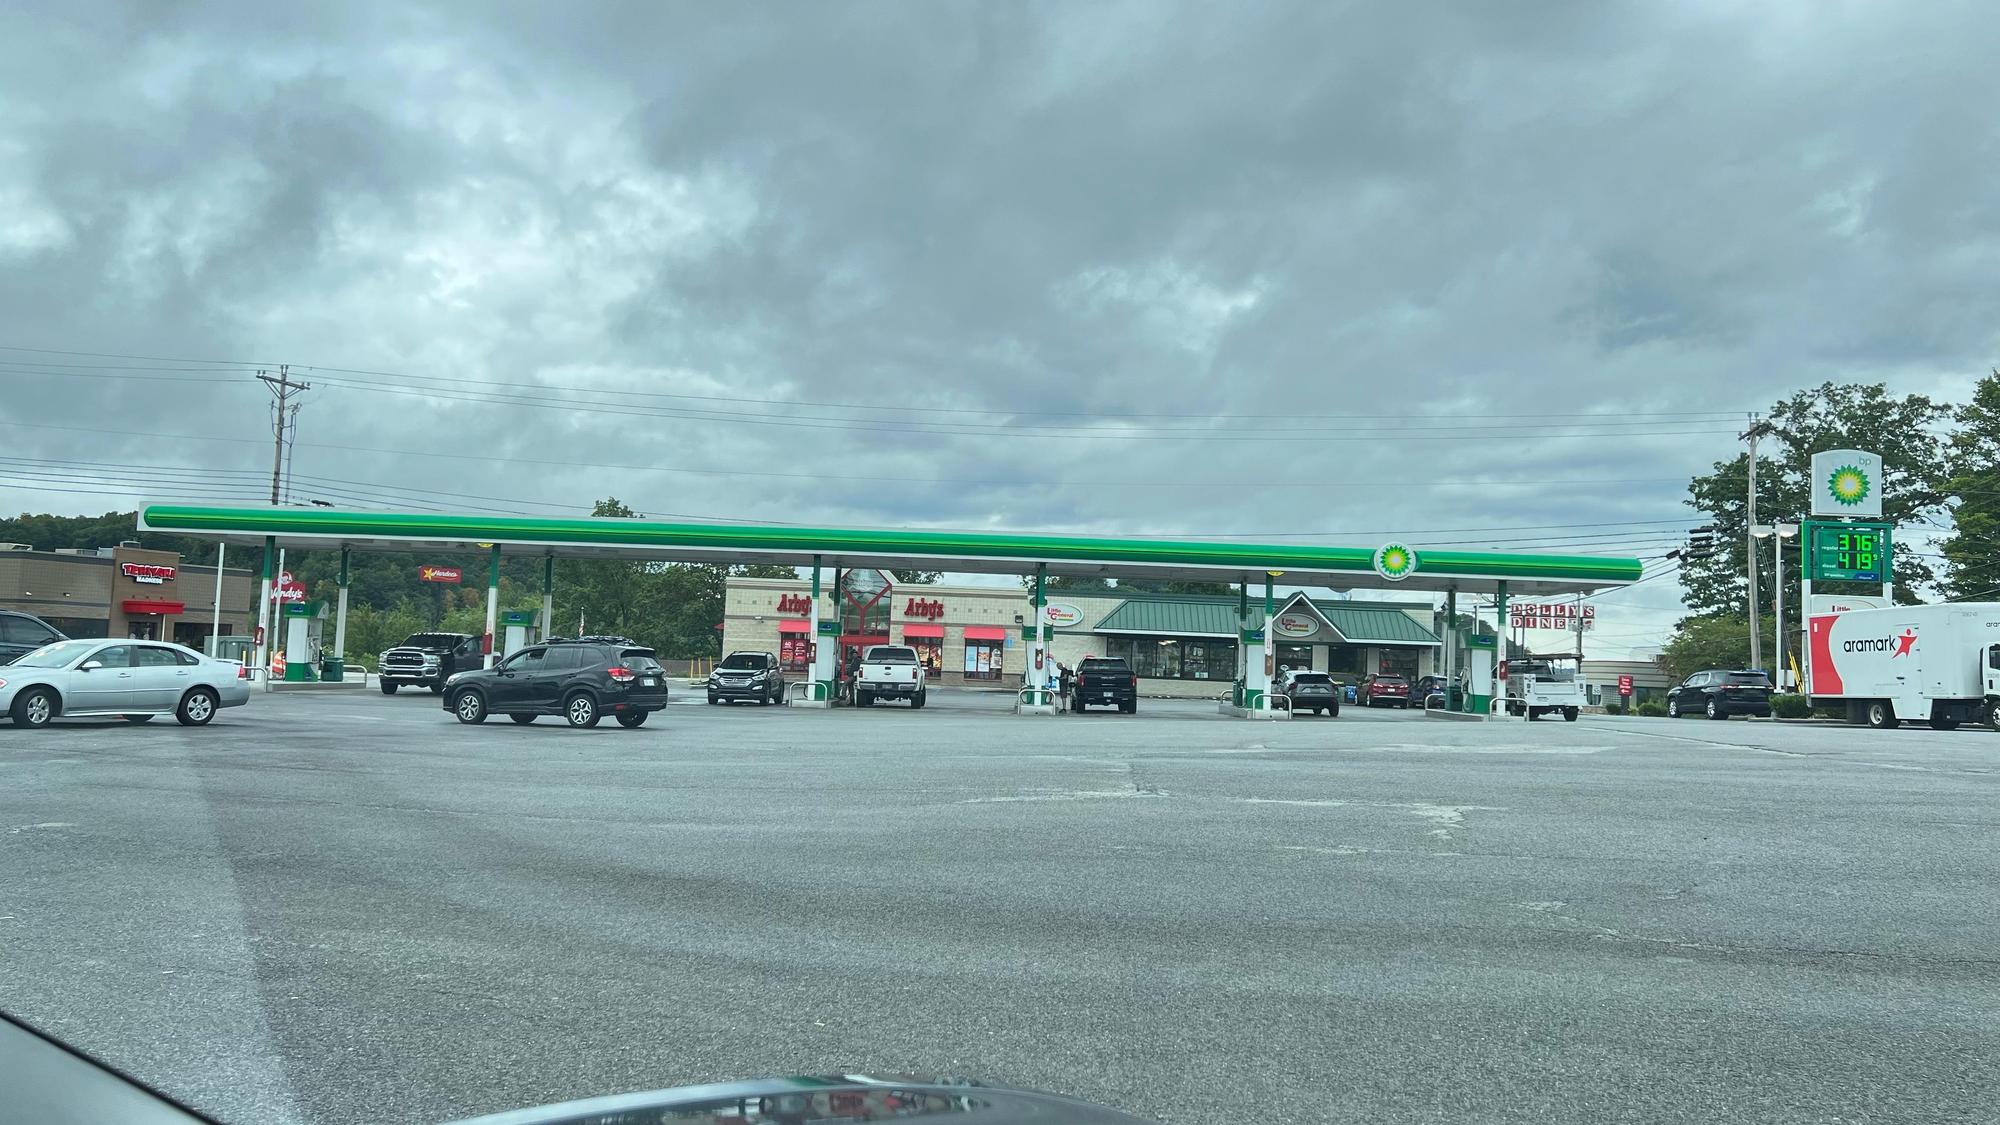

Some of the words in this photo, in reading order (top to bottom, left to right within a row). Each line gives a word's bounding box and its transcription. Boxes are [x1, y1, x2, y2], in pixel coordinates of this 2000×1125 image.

[1859, 456, 1871, 466] bp
[904, 597, 944, 621] Arby's
[1843, 634, 1896, 653] aramark
